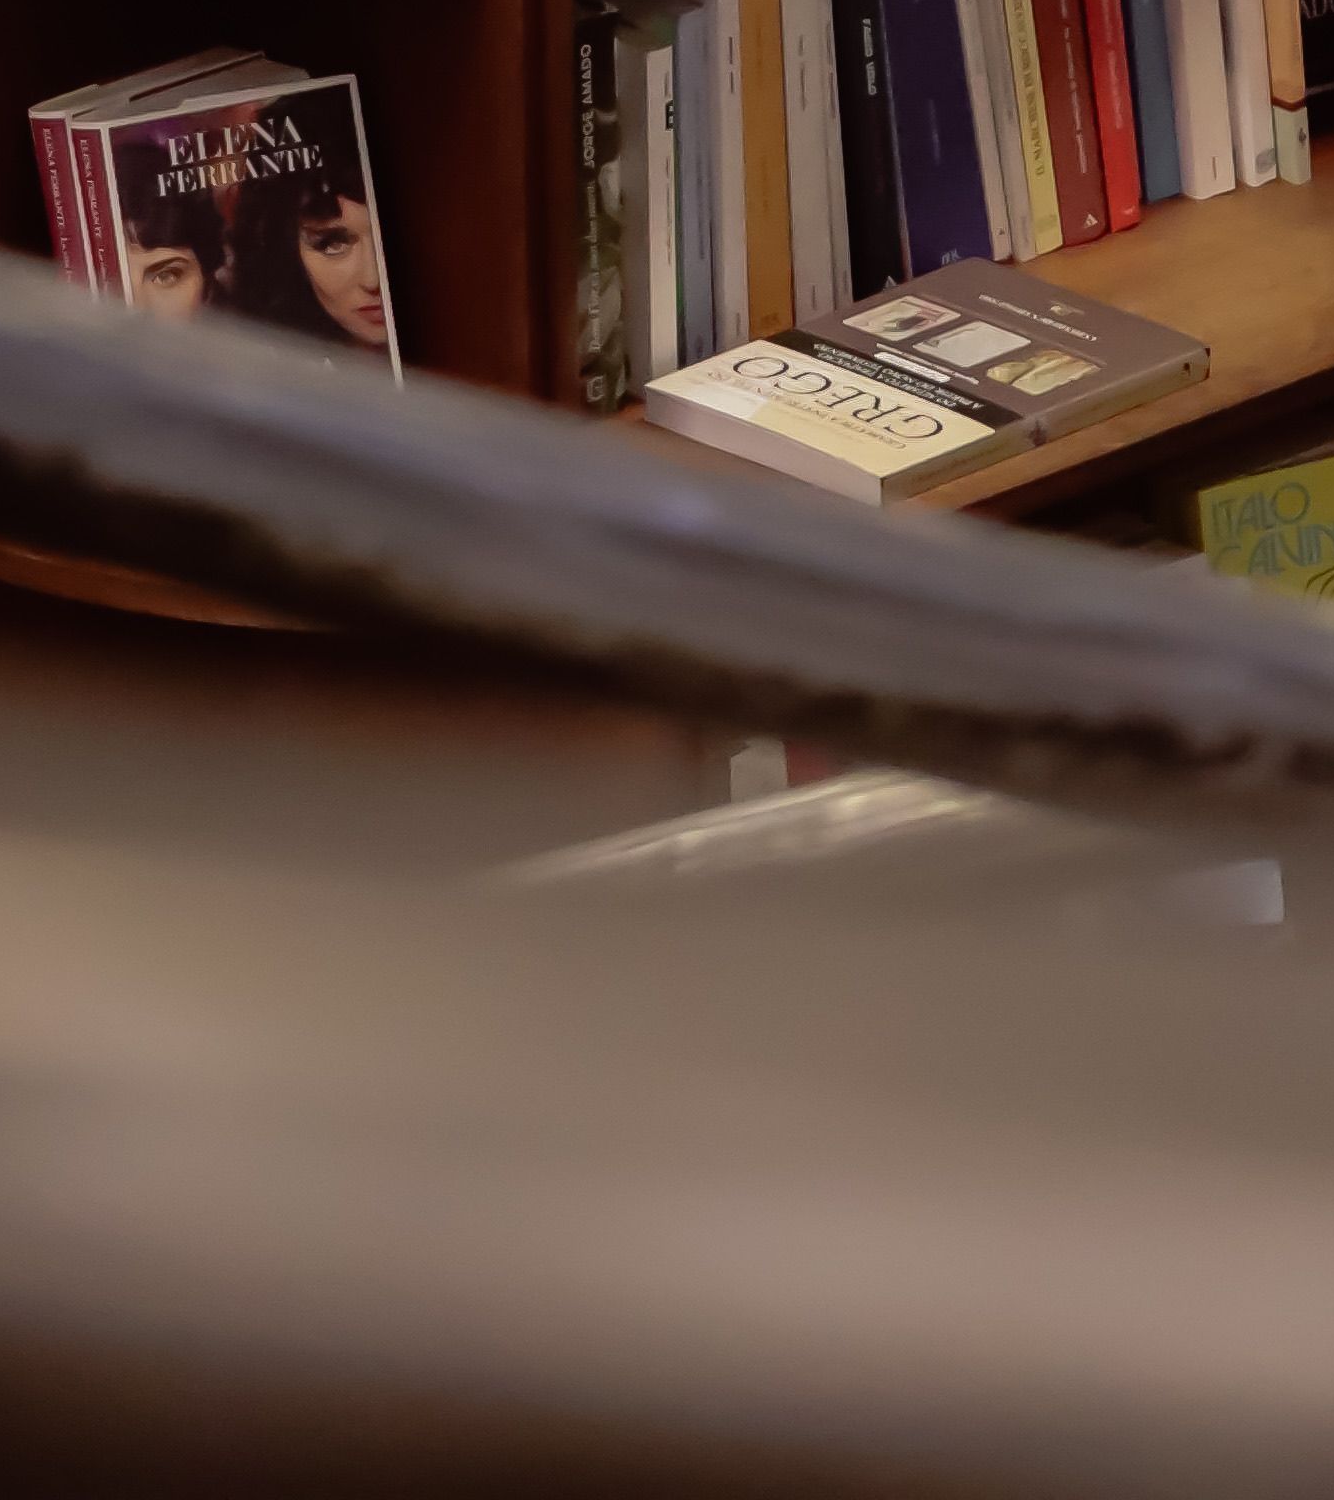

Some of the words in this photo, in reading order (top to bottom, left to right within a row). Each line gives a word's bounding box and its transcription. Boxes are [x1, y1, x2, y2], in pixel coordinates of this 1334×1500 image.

[581, 43, 593, 103] AMADO
[167, 115, 304, 167] ELENA
[155, 142, 325, 198] FERRANTE
[1212, 482, 1310, 533] ITALO
